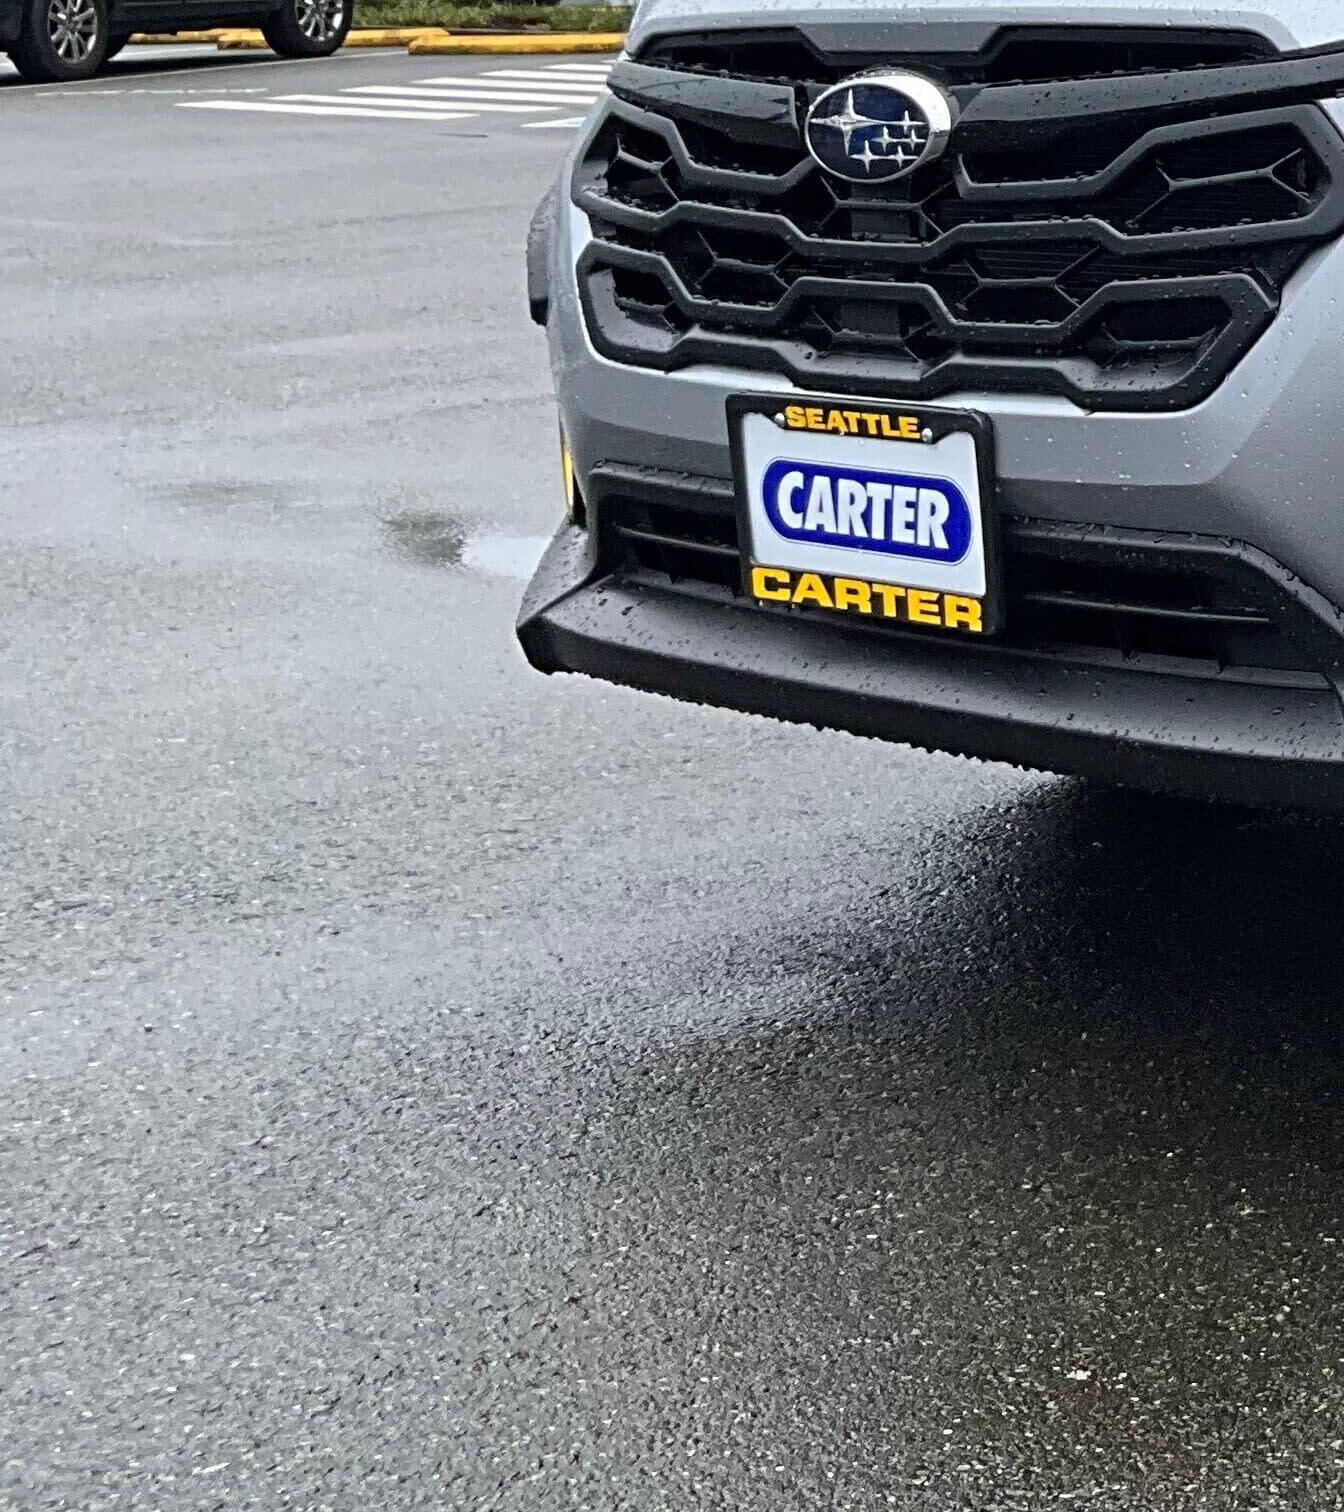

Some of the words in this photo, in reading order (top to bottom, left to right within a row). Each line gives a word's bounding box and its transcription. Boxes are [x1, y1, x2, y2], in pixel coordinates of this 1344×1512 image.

[784, 405, 921, 439] SEATTLE
[776, 471, 950, 549] CARTER
[752, 567, 983, 632] CARTER
